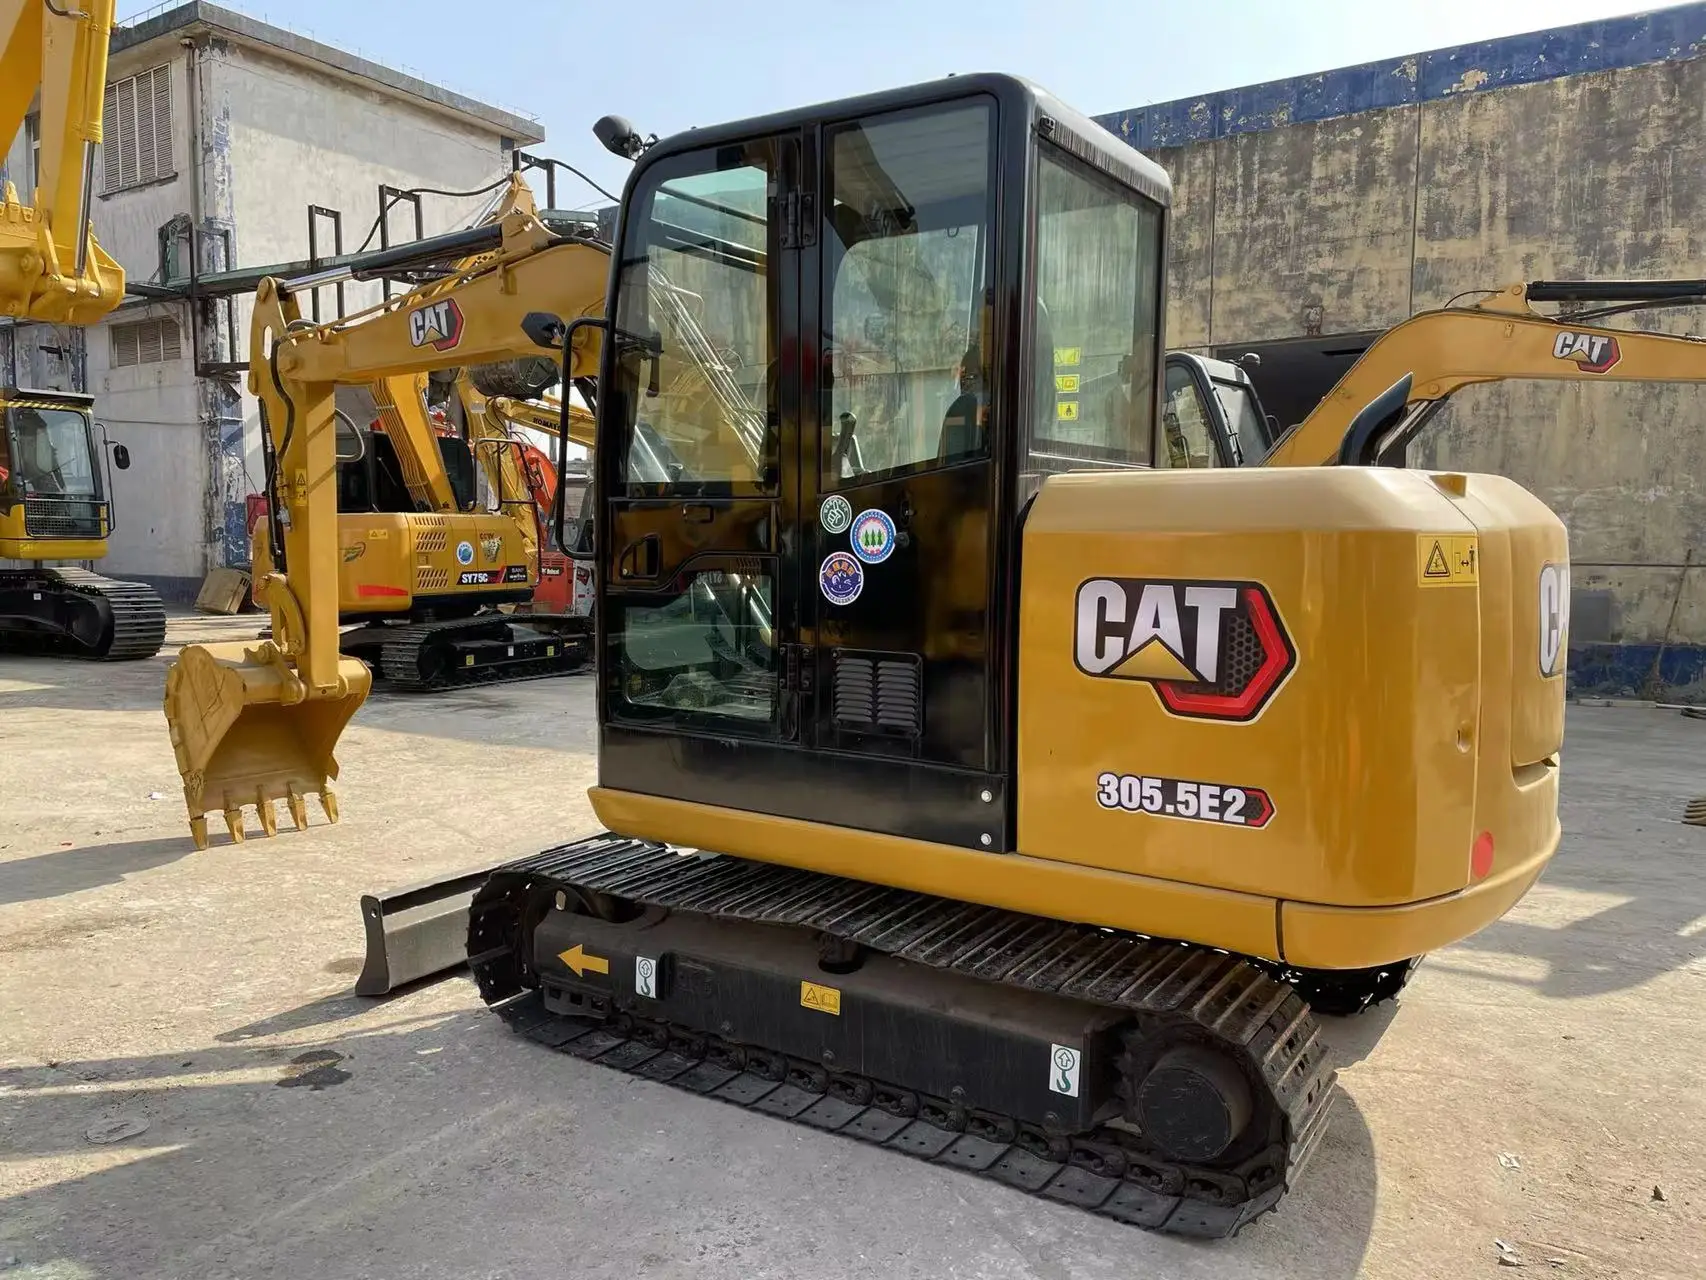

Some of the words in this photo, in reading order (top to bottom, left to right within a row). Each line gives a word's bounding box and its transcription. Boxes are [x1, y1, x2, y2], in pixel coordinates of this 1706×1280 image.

[410, 301, 449, 346] CAT
[1554, 331, 1609, 363] CAT
[533, 417, 560, 431] KOMAT
[461, 573, 489, 584] SY75C
[1077, 579, 1237, 683] CAT
[1098, 773, 1246, 823] 305.5E2
